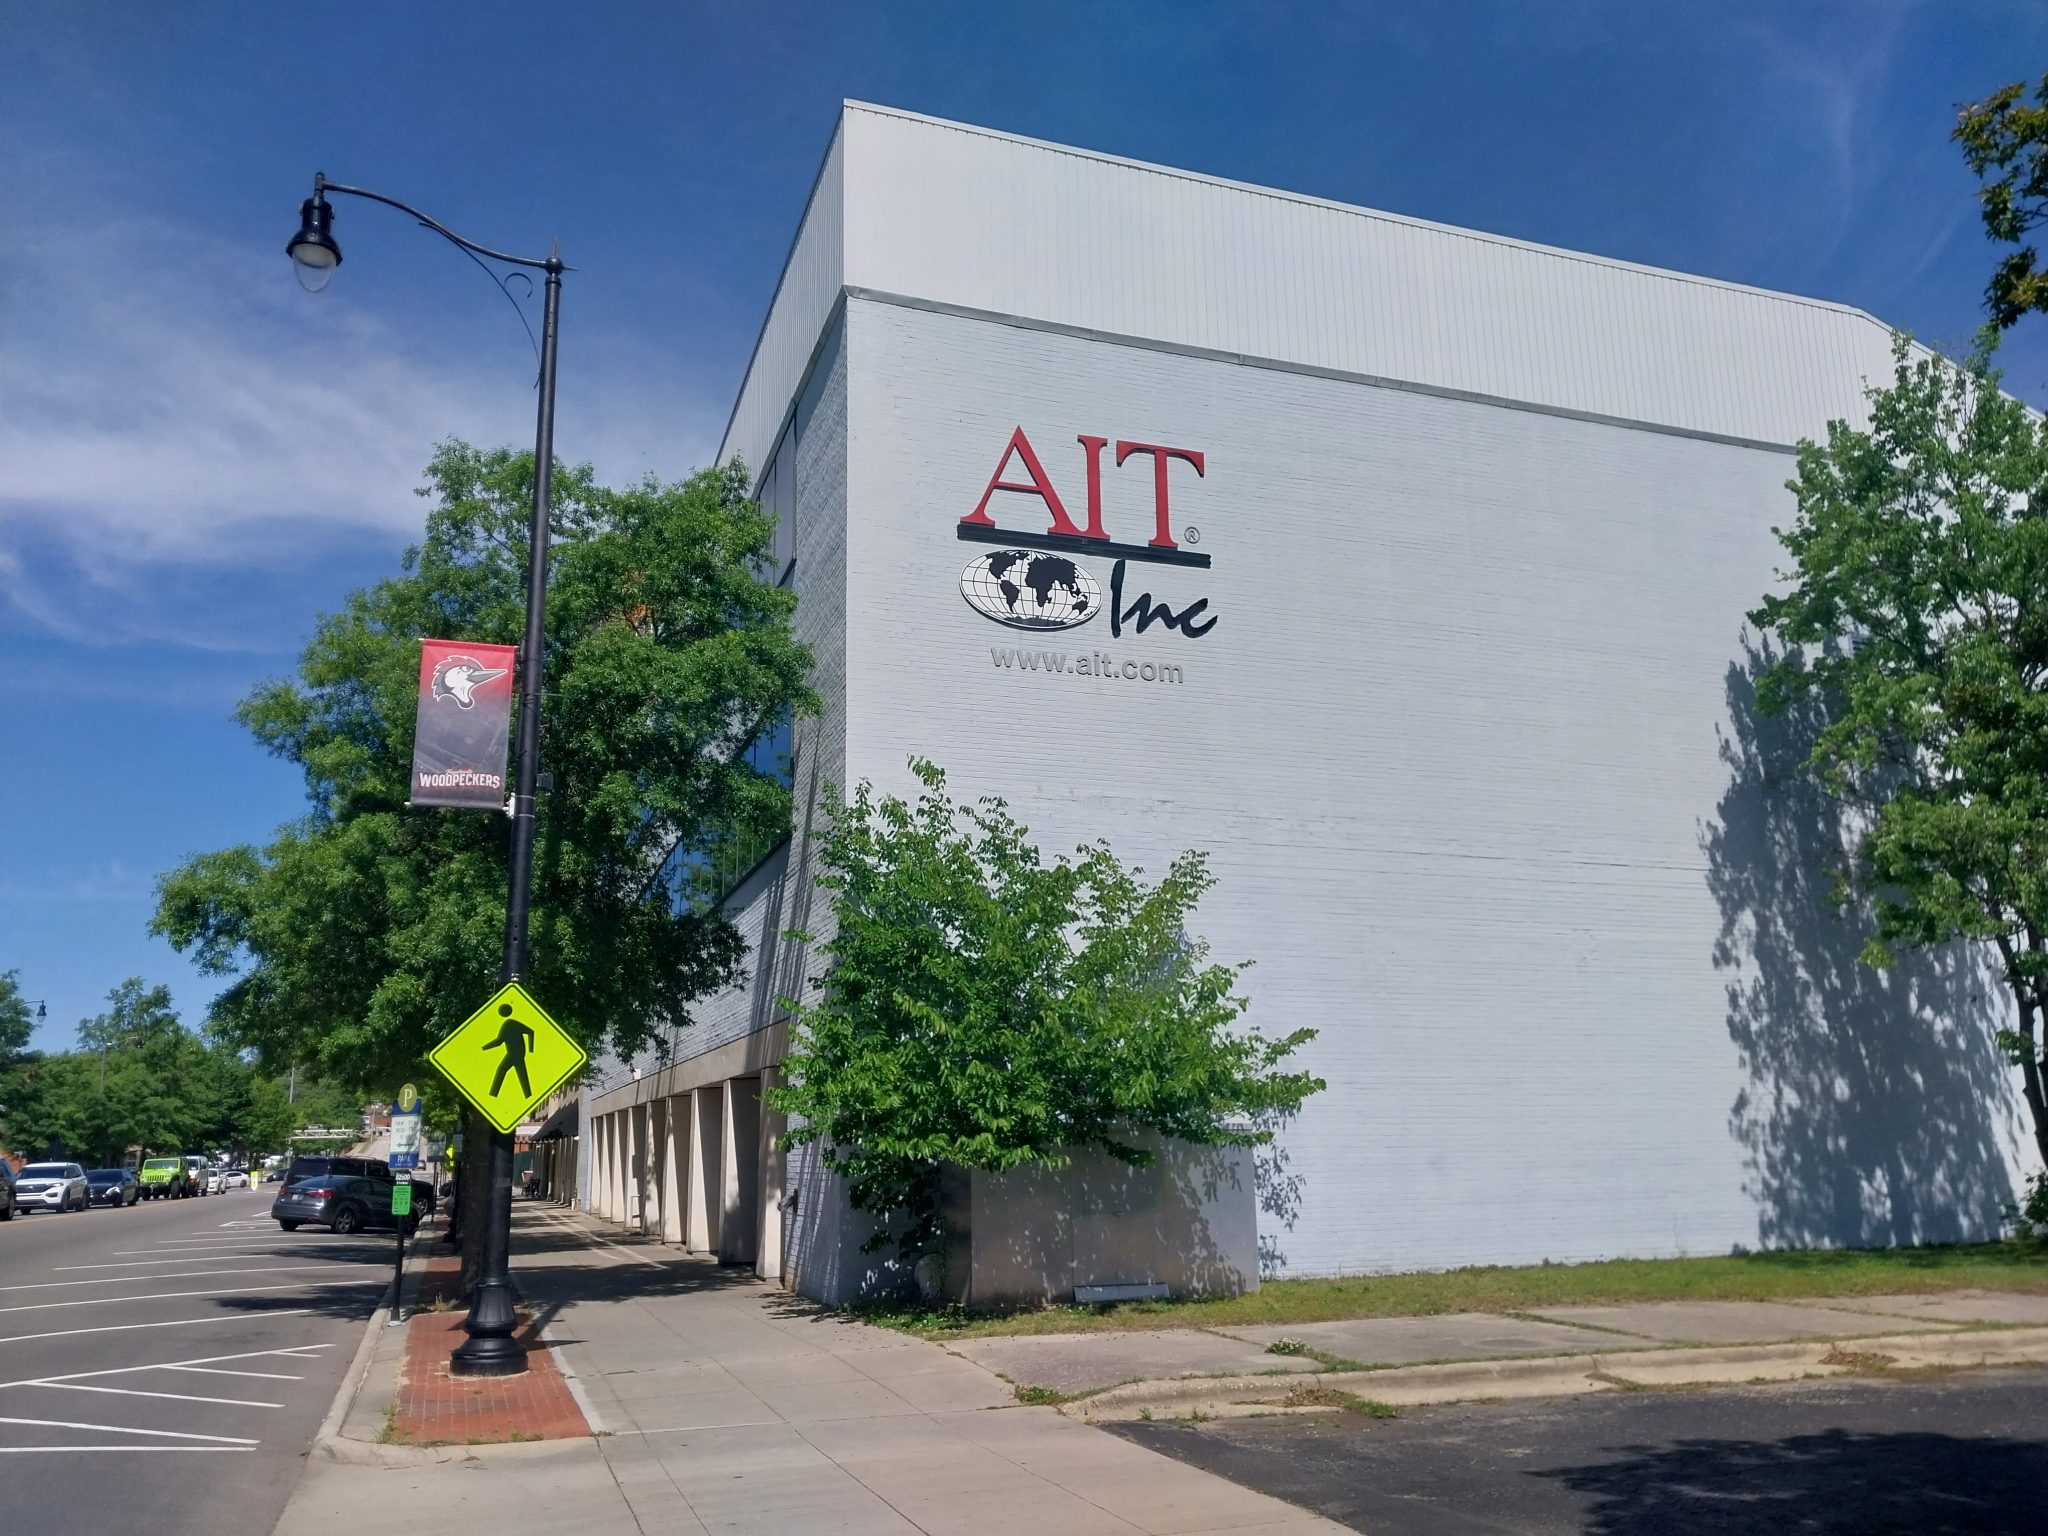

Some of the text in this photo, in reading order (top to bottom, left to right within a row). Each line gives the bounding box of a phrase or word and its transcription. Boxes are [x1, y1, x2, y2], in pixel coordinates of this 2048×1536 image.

[960, 425, 1205, 550] AIT
[1110, 559, 1218, 639] Inc
[991, 648, 1184, 683] www.ait.com
[419, 772, 501, 789] WOODPECKERS
[403, 1088, 413, 1107] P
